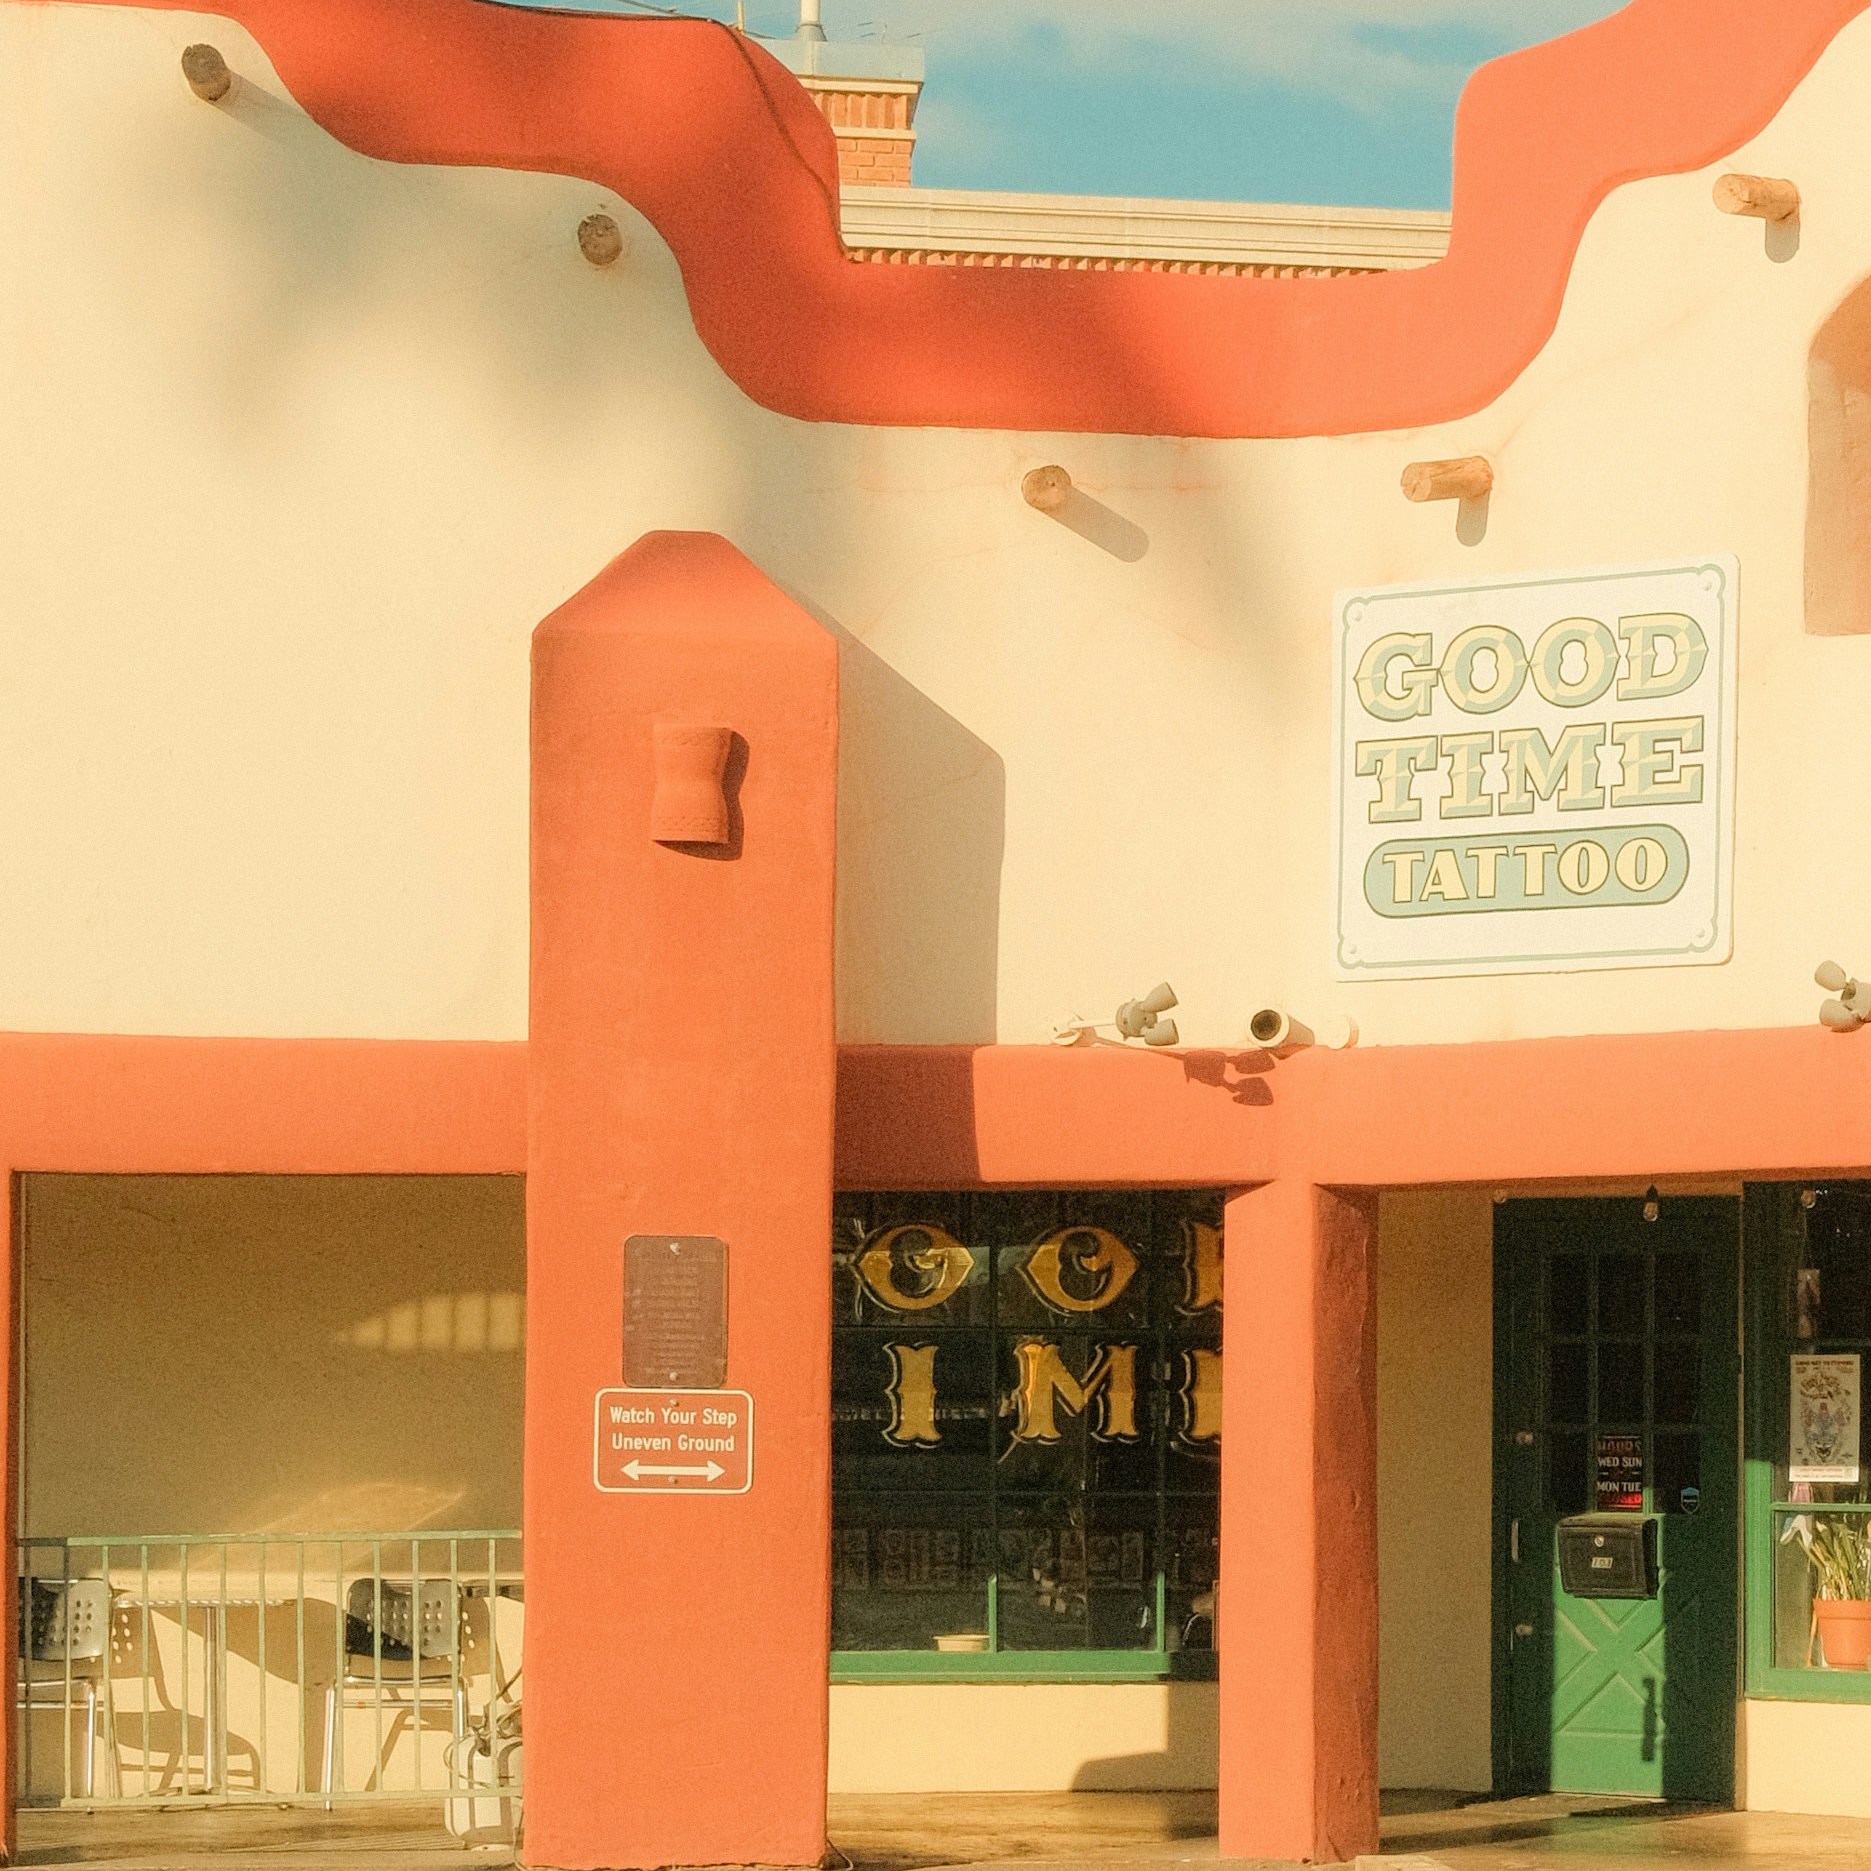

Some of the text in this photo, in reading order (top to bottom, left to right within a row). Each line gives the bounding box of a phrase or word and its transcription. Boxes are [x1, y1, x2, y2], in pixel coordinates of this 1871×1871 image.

[1353, 612, 1709, 723] GOOD
[1355, 715, 1704, 824] TIME
[1383, 837, 1668, 904] TATTOO
[609, 1405, 737, 1430] Watch Your Step
[611, 1432, 735, 1452] Uneven Ground
[1598, 1456, 1642, 1467] WED SUN
[1597, 1482, 1641, 1492] MON TUE
